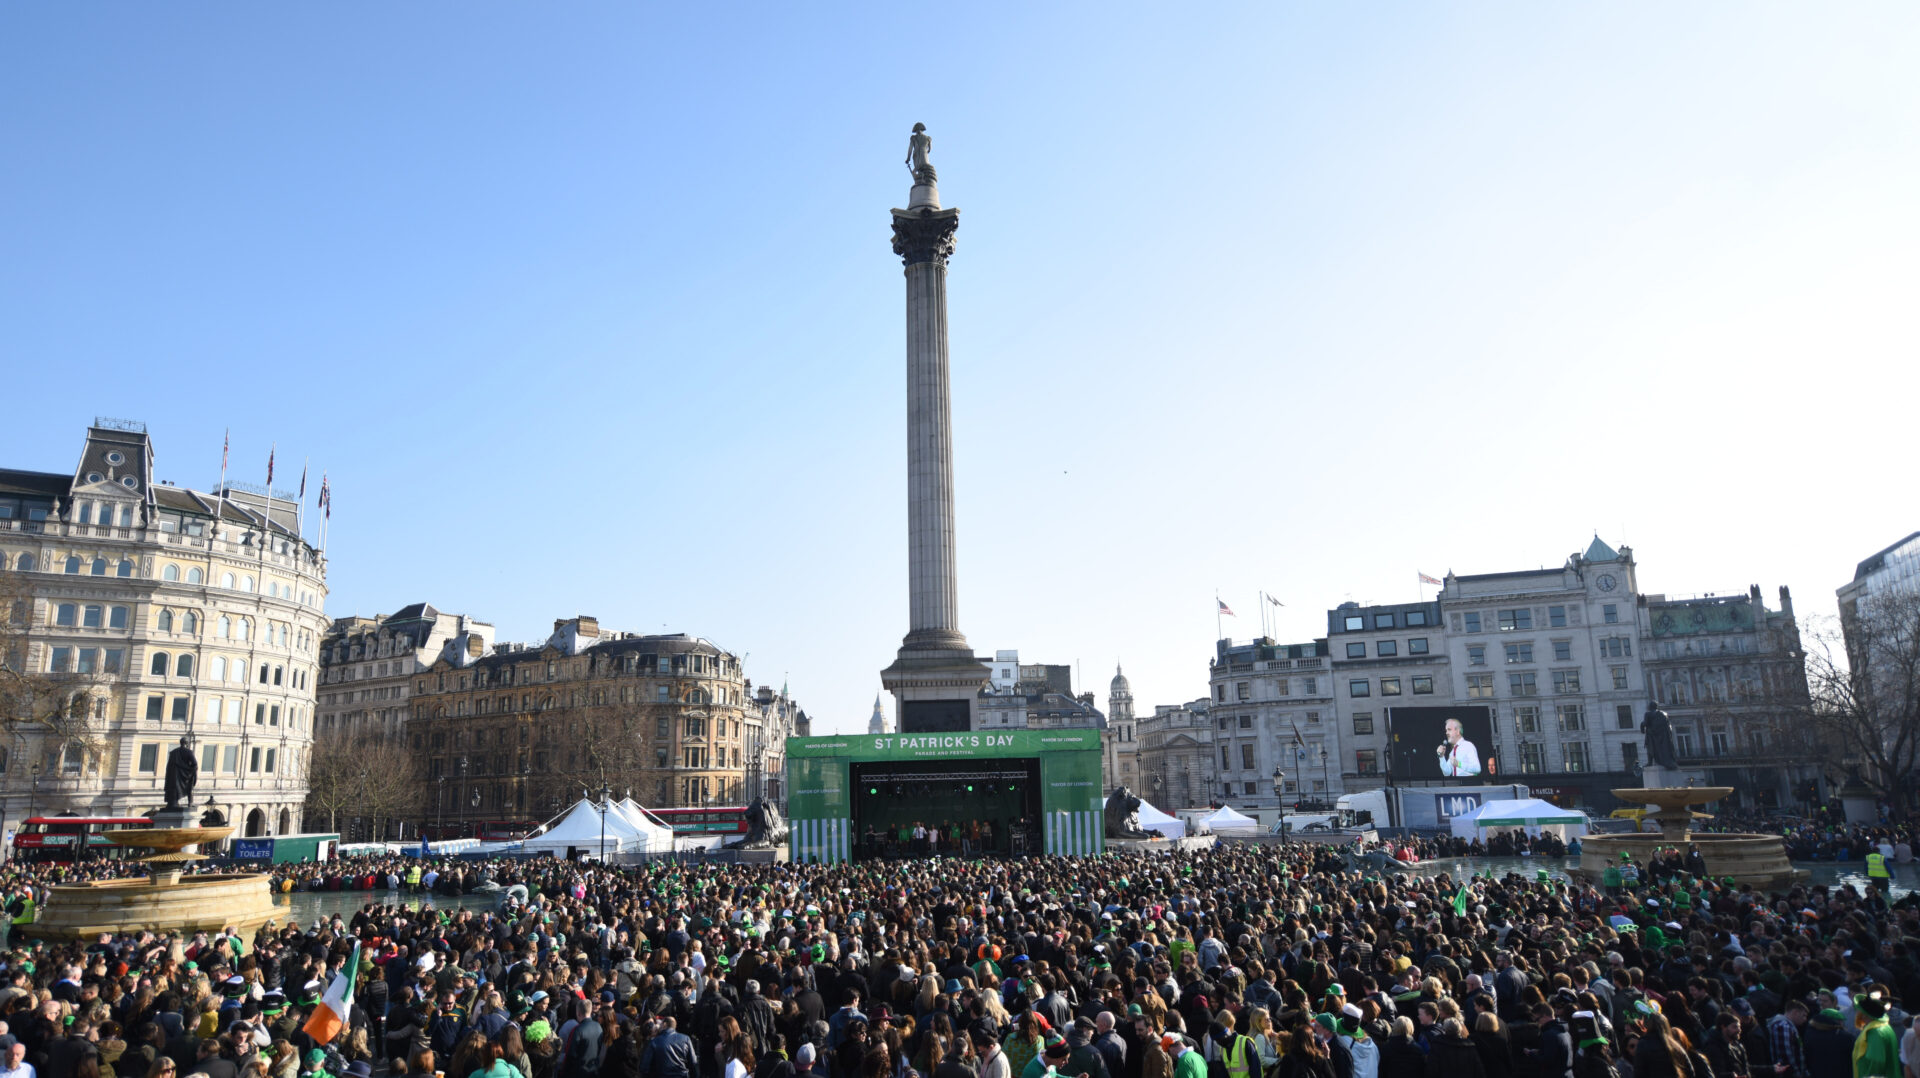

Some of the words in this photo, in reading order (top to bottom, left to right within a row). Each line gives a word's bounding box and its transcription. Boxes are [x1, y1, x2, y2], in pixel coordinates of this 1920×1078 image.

[874, 738, 893, 749] ST
[900, 735, 980, 749] PATRICK'S
[986, 735, 1014, 746] DAY
[1440, 796, 1477, 816] LMD
[239, 850, 270, 858] TOILETS
